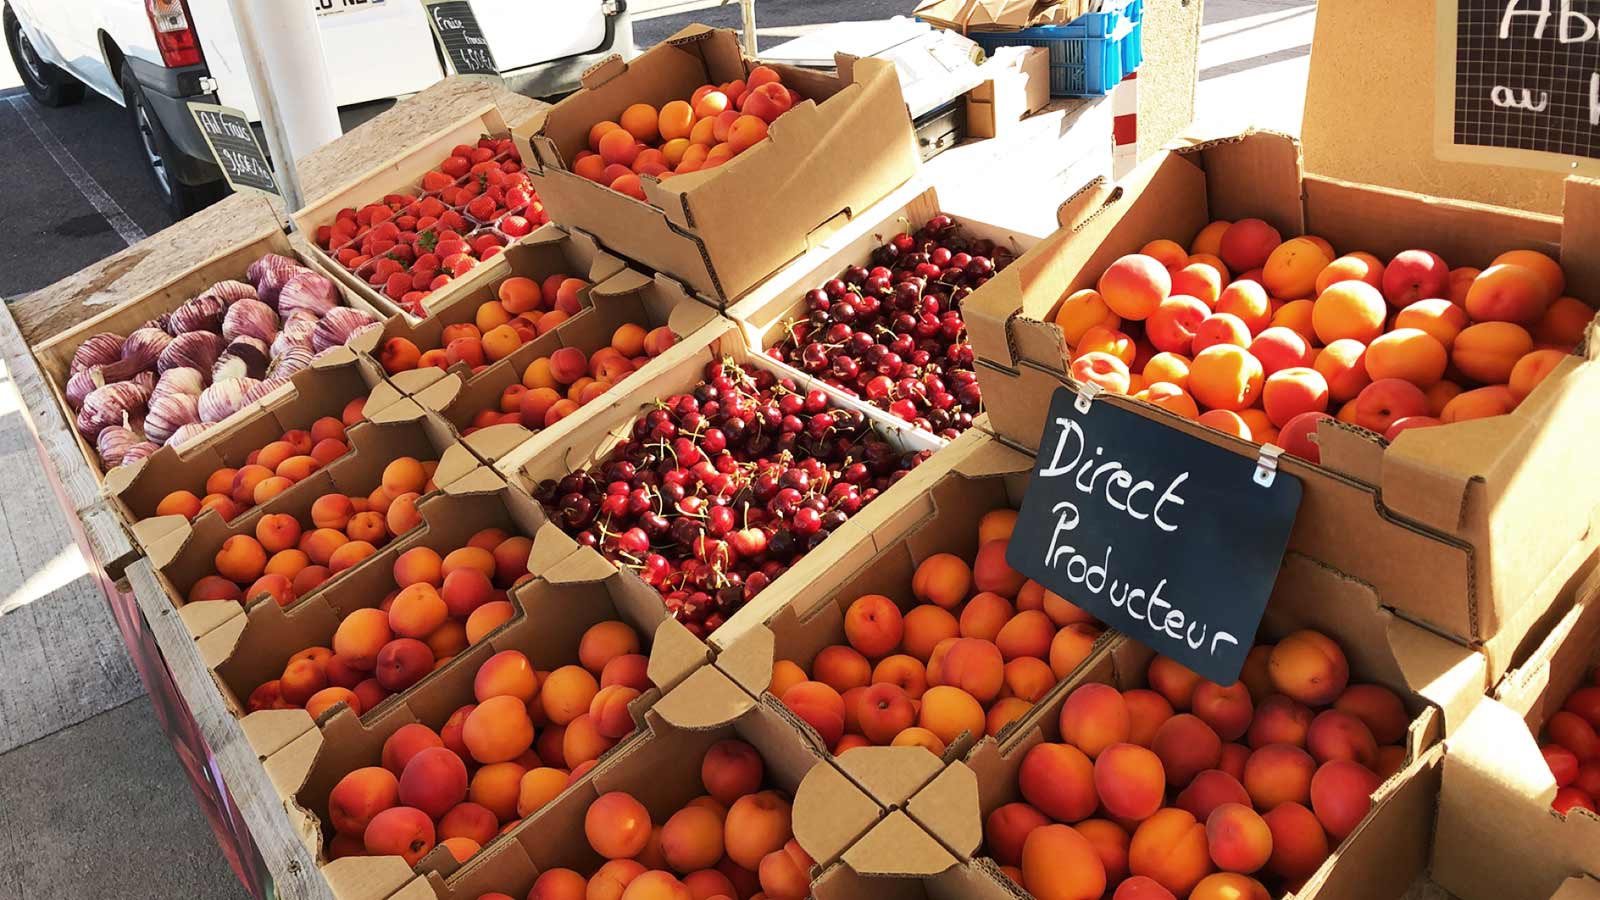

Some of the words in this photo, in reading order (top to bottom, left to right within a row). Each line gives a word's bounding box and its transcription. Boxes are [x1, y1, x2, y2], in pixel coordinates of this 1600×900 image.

[1500, 0, 1600, 43] Ab
[1491, 85, 1547, 112] au
[1040, 417, 1188, 531] Direct
[1045, 502, 1238, 655] Producteur
